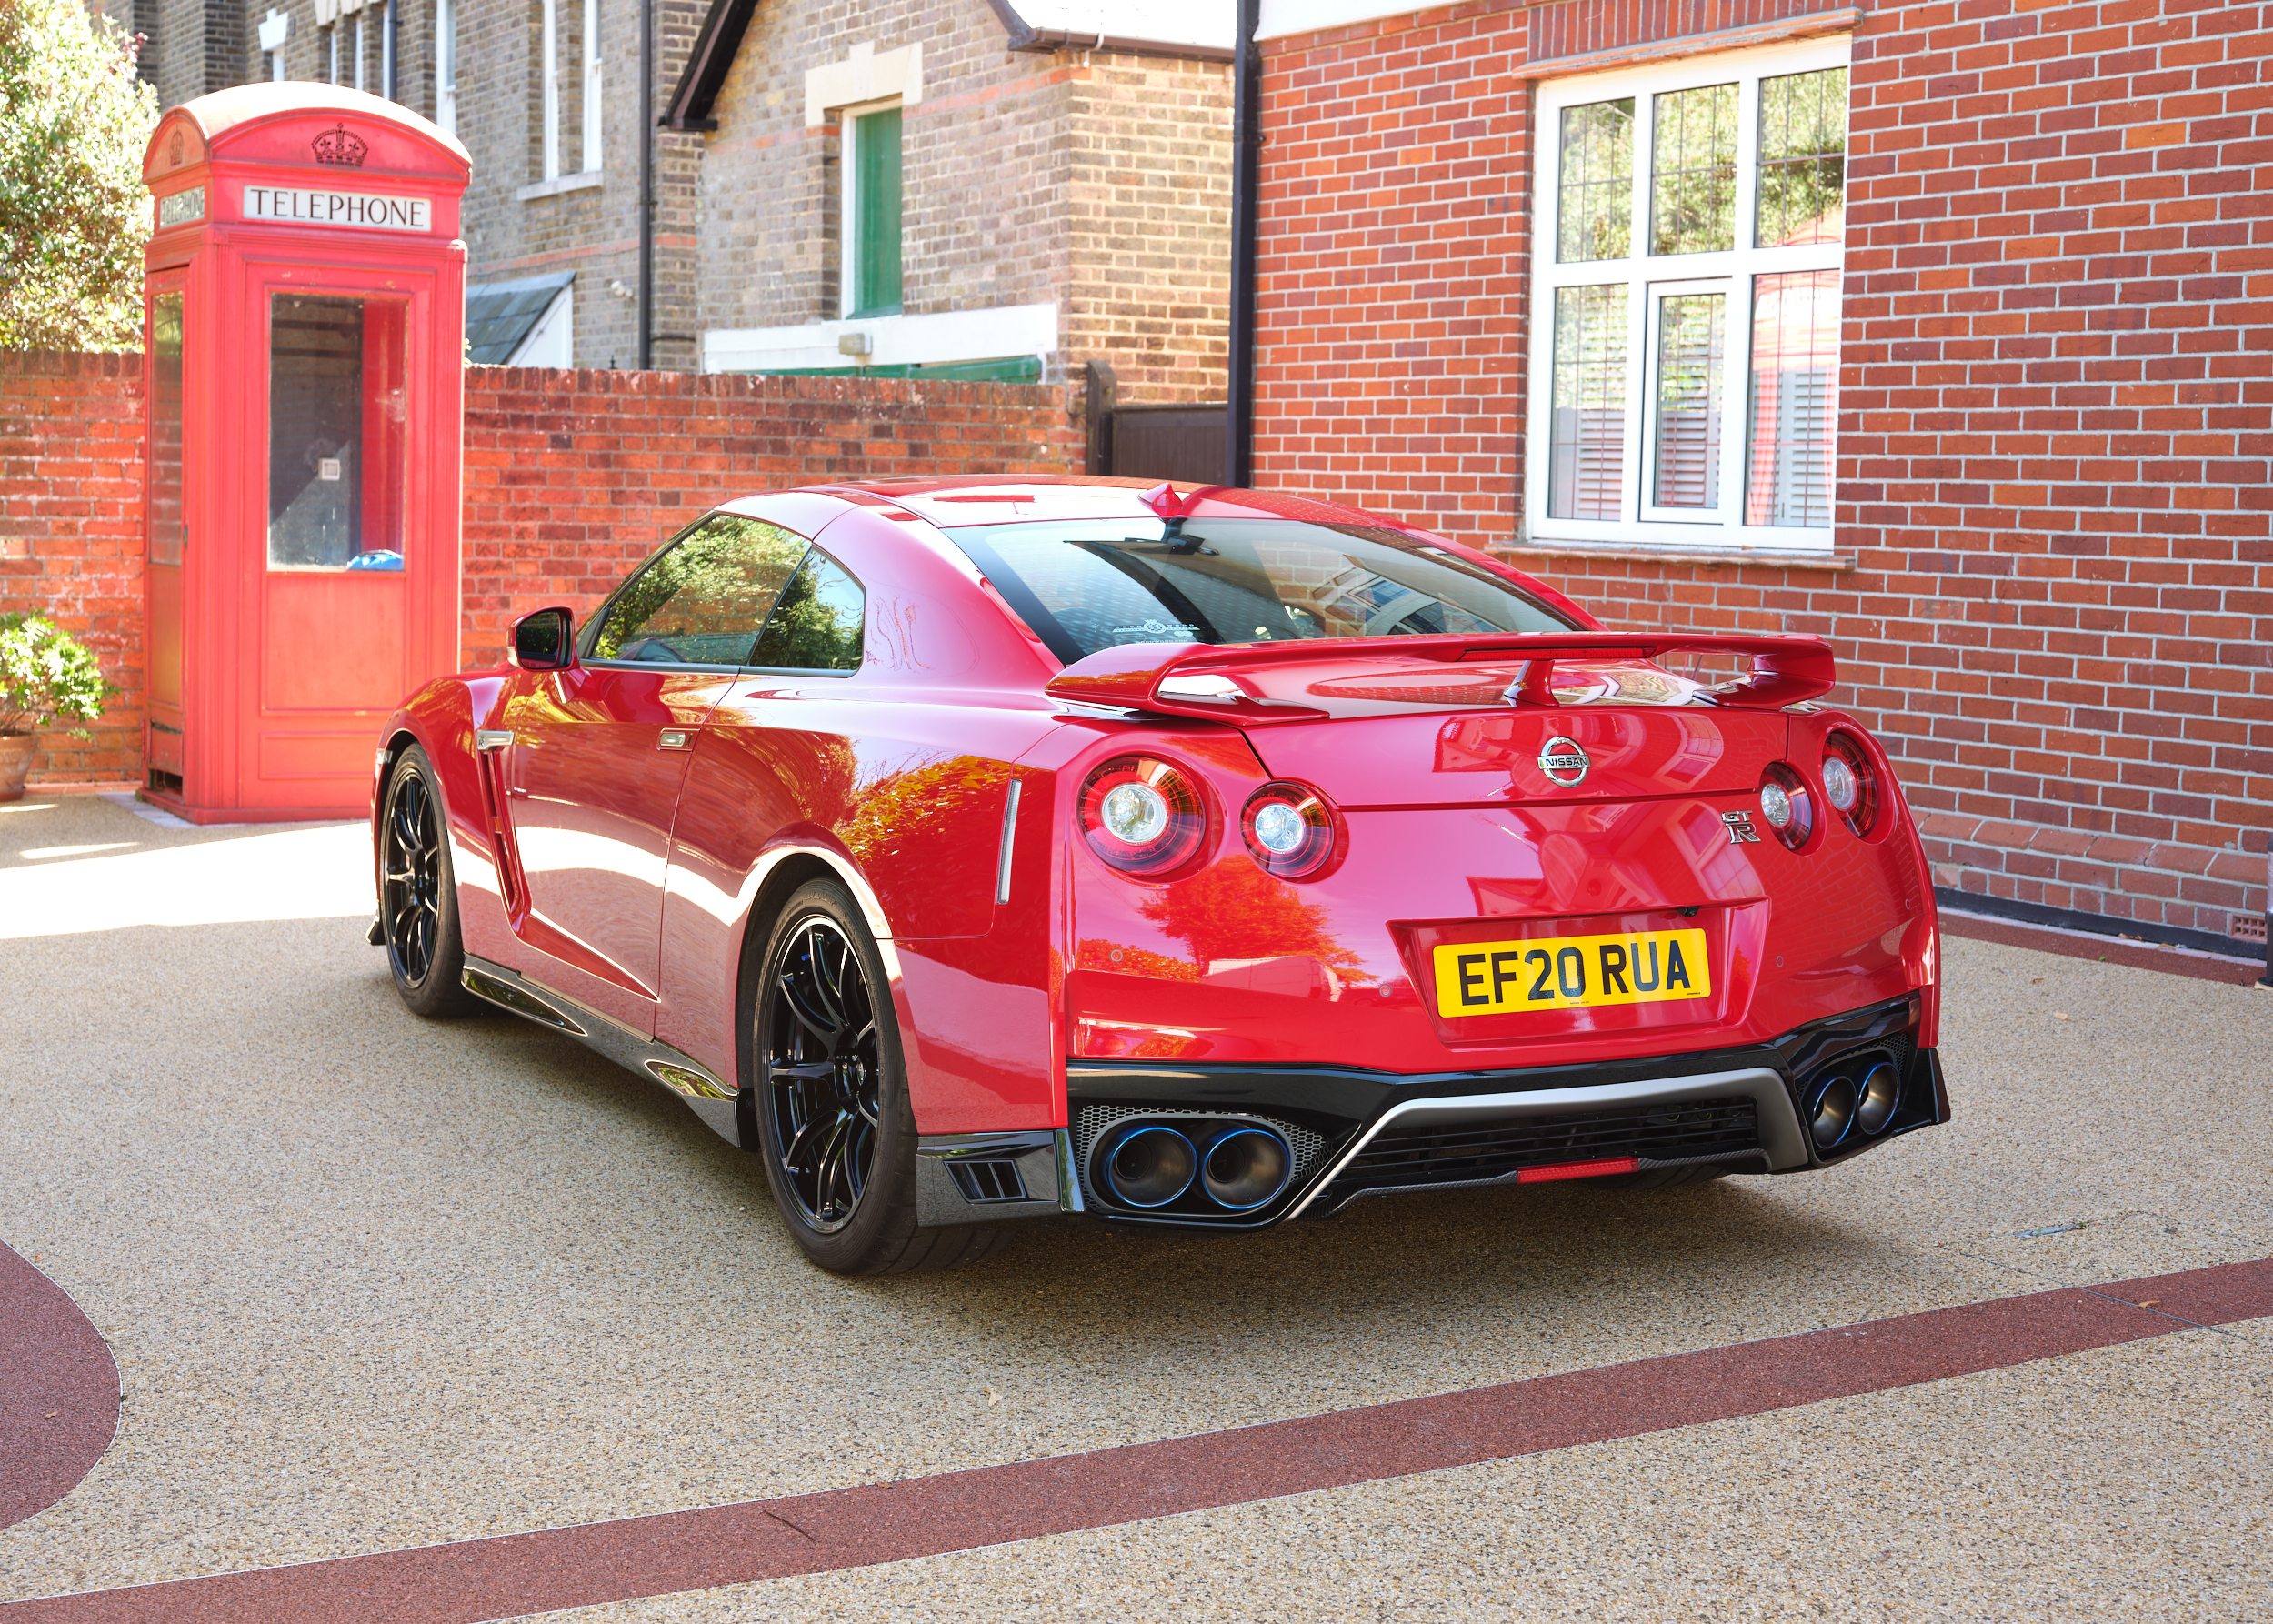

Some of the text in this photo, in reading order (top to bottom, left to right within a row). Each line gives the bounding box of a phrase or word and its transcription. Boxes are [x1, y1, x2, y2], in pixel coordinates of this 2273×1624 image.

[250, 188, 425, 227] TELEPHONE
[1545, 757, 1588, 767] NISSAN
[1721, 810, 1753, 823] GT
[1725, 821, 1761, 844] R
[1457, 940, 1691, 1006] EF20 RUA
